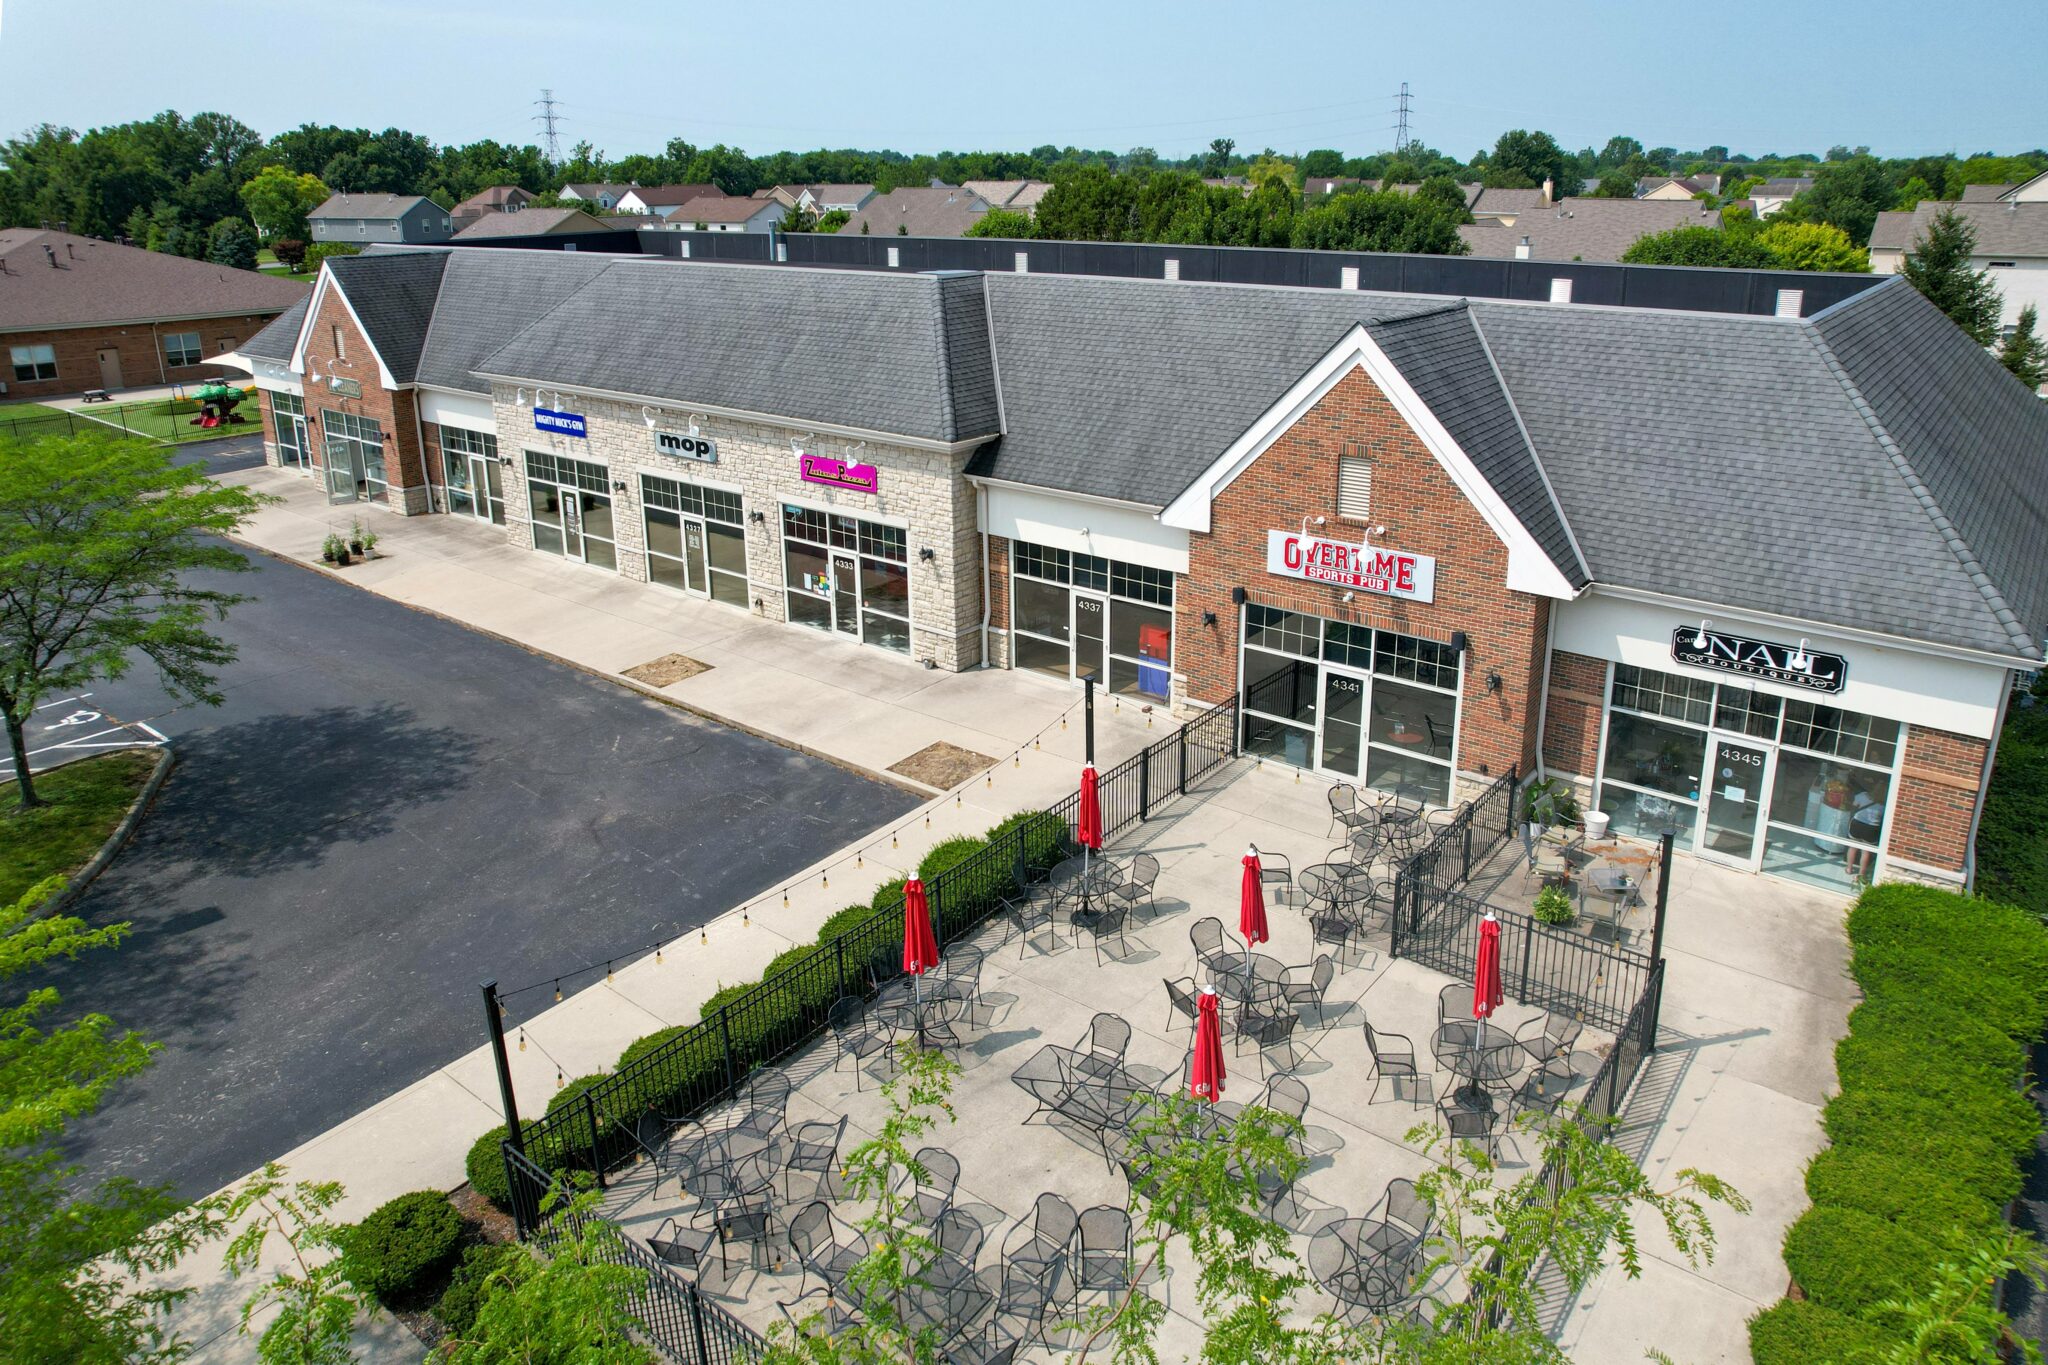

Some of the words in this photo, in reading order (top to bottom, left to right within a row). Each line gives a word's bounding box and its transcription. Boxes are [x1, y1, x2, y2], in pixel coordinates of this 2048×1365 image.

[572, 420, 584, 431] GYM
[660, 434, 710, 458] mop
[835, 560, 853, 570] 4333
[1284, 537, 1416, 591] OVERTIME
[1308, 567, 1354, 584] SPORTS
[1360, 578, 1384, 590] PUB
[1078, 600, 1100, 612] 4337
[1704, 635, 1835, 679] NAIL
[1707, 658, 1806, 683] BOUTIQUE
[1332, 679, 1359, 693] 4341
[1721, 749, 1761, 766] 4345
